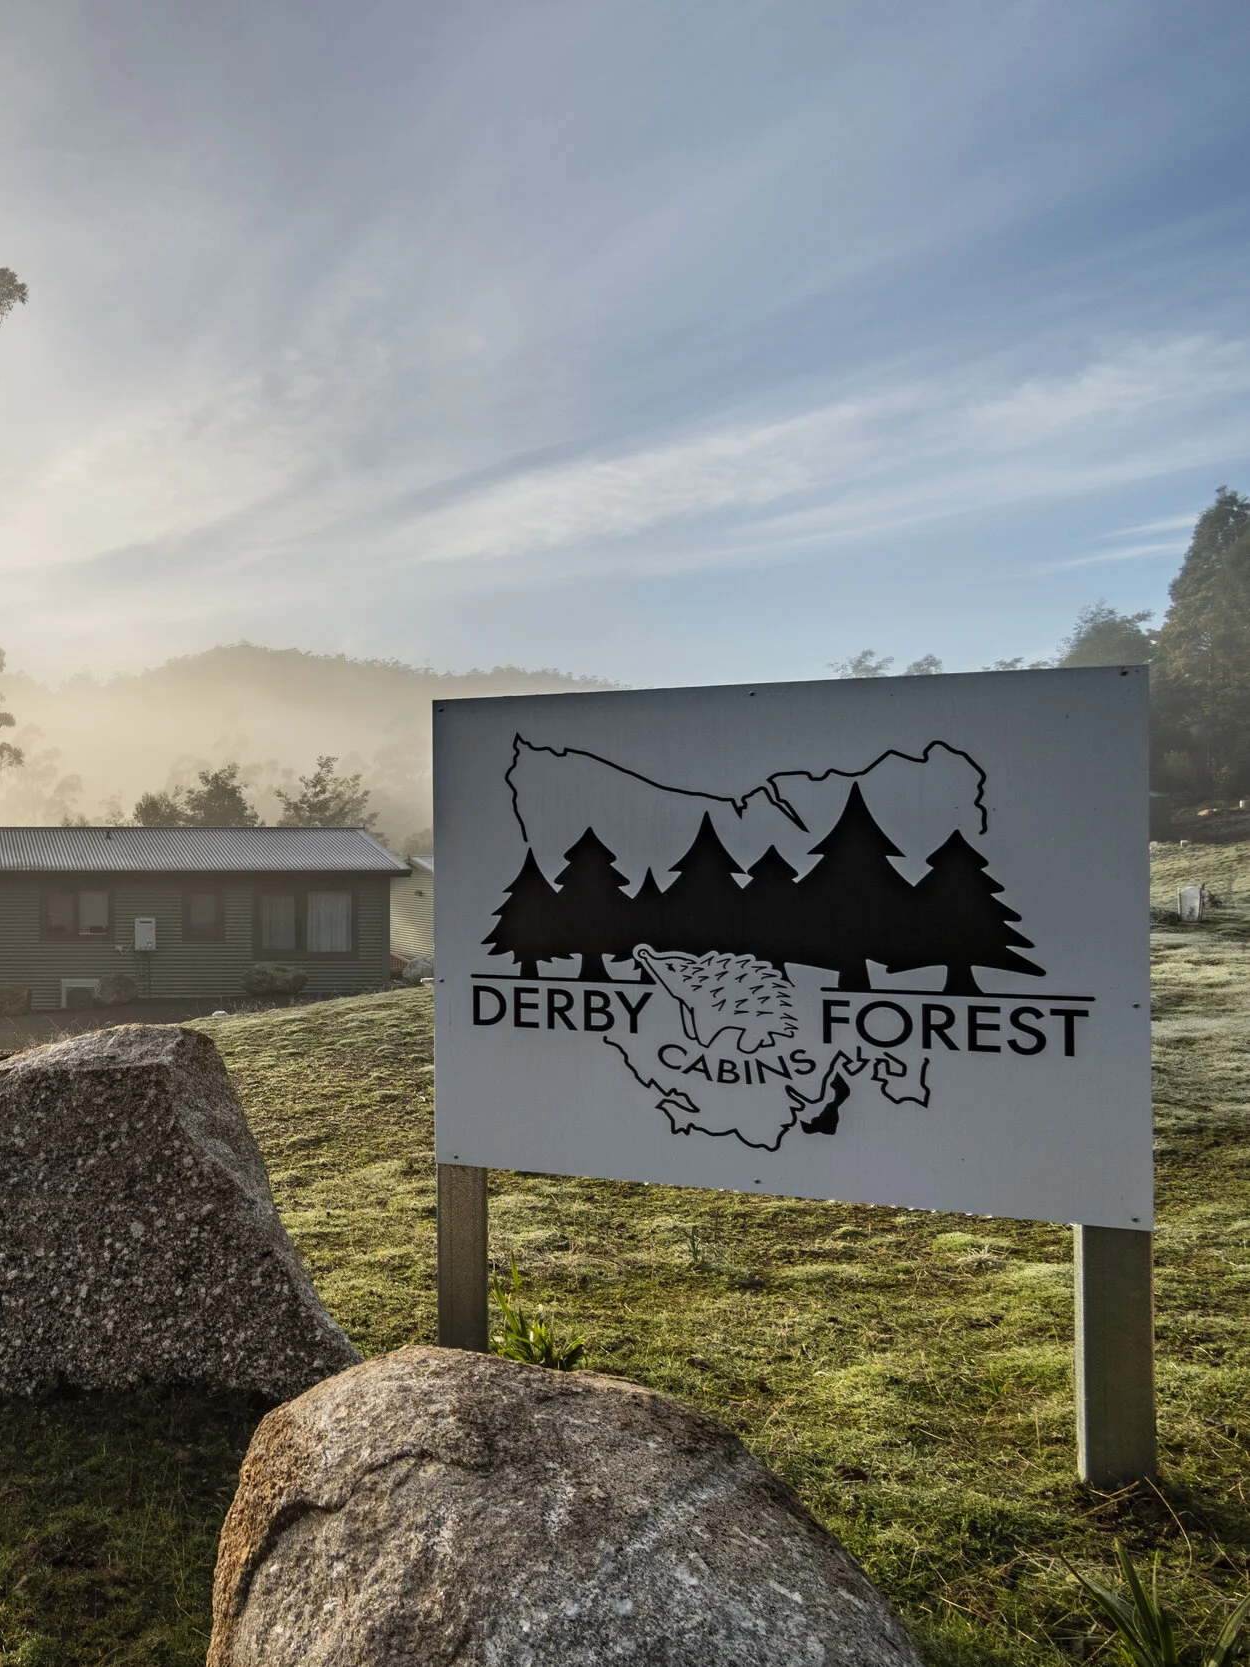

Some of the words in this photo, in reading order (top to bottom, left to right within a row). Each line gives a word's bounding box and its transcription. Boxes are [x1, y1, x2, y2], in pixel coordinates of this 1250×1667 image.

[472, 985, 653, 1034] DERBY
[822, 999, 1089, 1057] FOREST
[657, 1043, 816, 1084] CABINS
